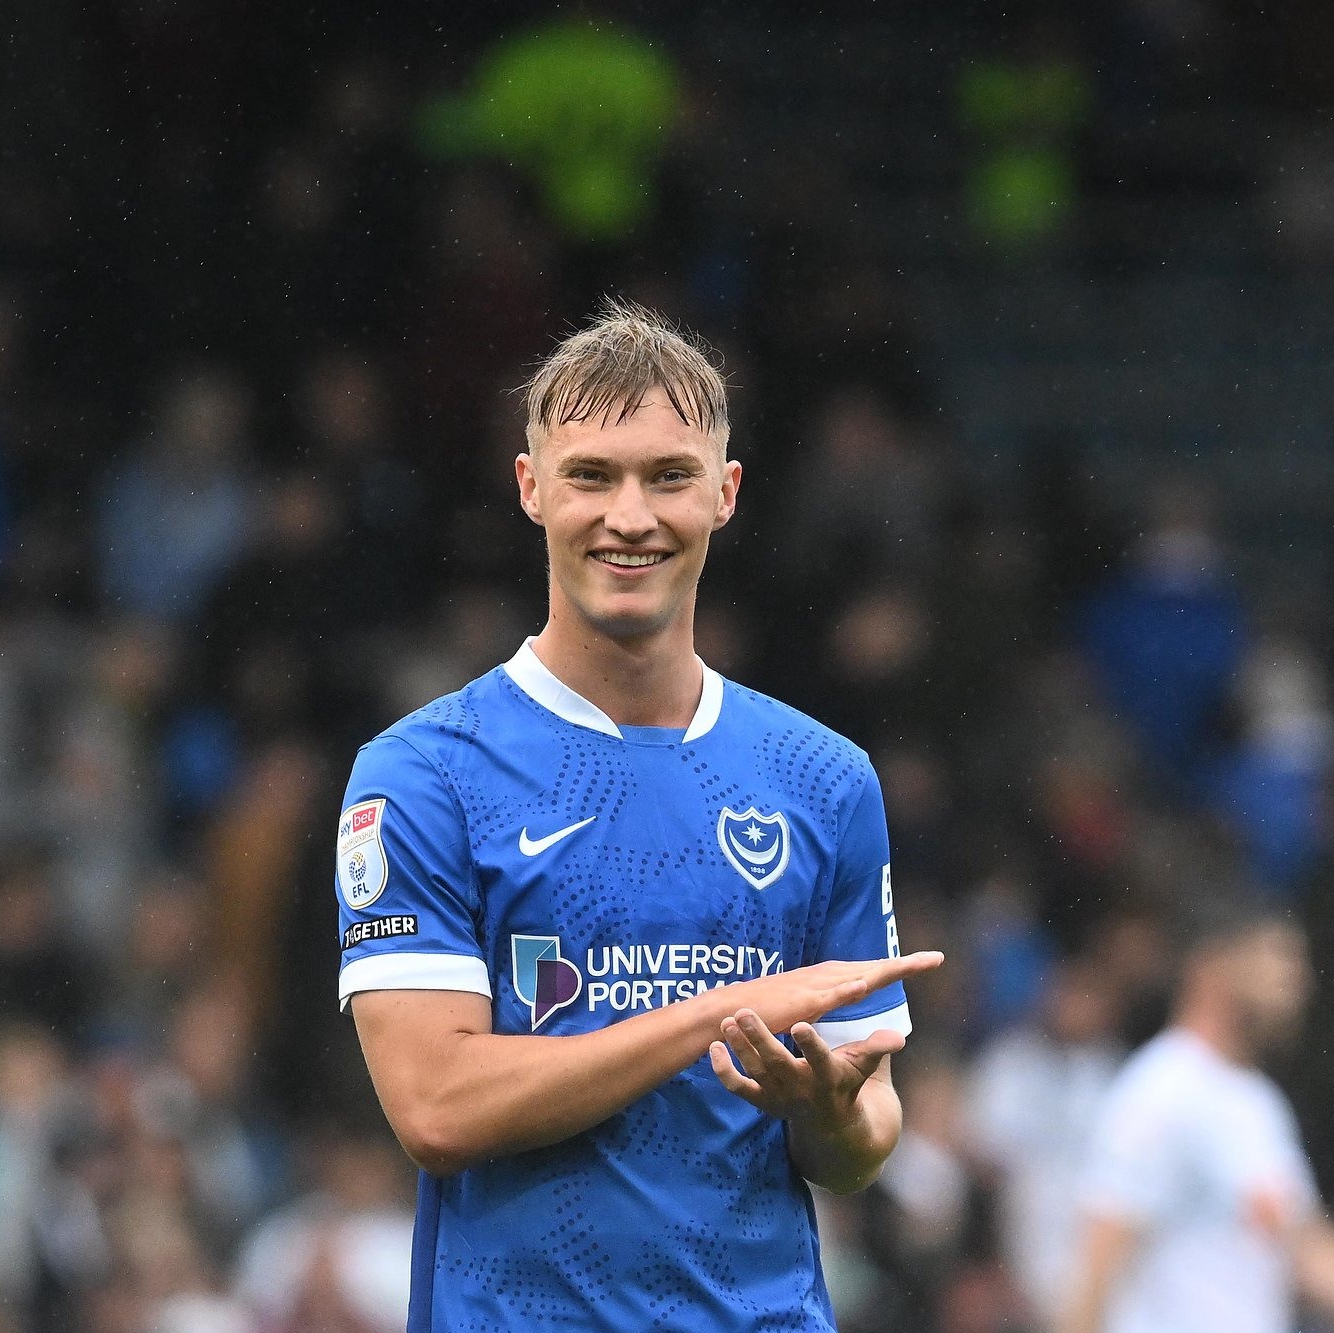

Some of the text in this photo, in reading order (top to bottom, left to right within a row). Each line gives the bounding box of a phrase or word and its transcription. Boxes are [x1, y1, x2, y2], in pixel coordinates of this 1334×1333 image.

[353, 809, 374, 828] bet
[352, 882, 370, 899] EFL
[587, 945, 780, 977] UNIVERSITY
[588, 980, 743, 1012] PORTS
